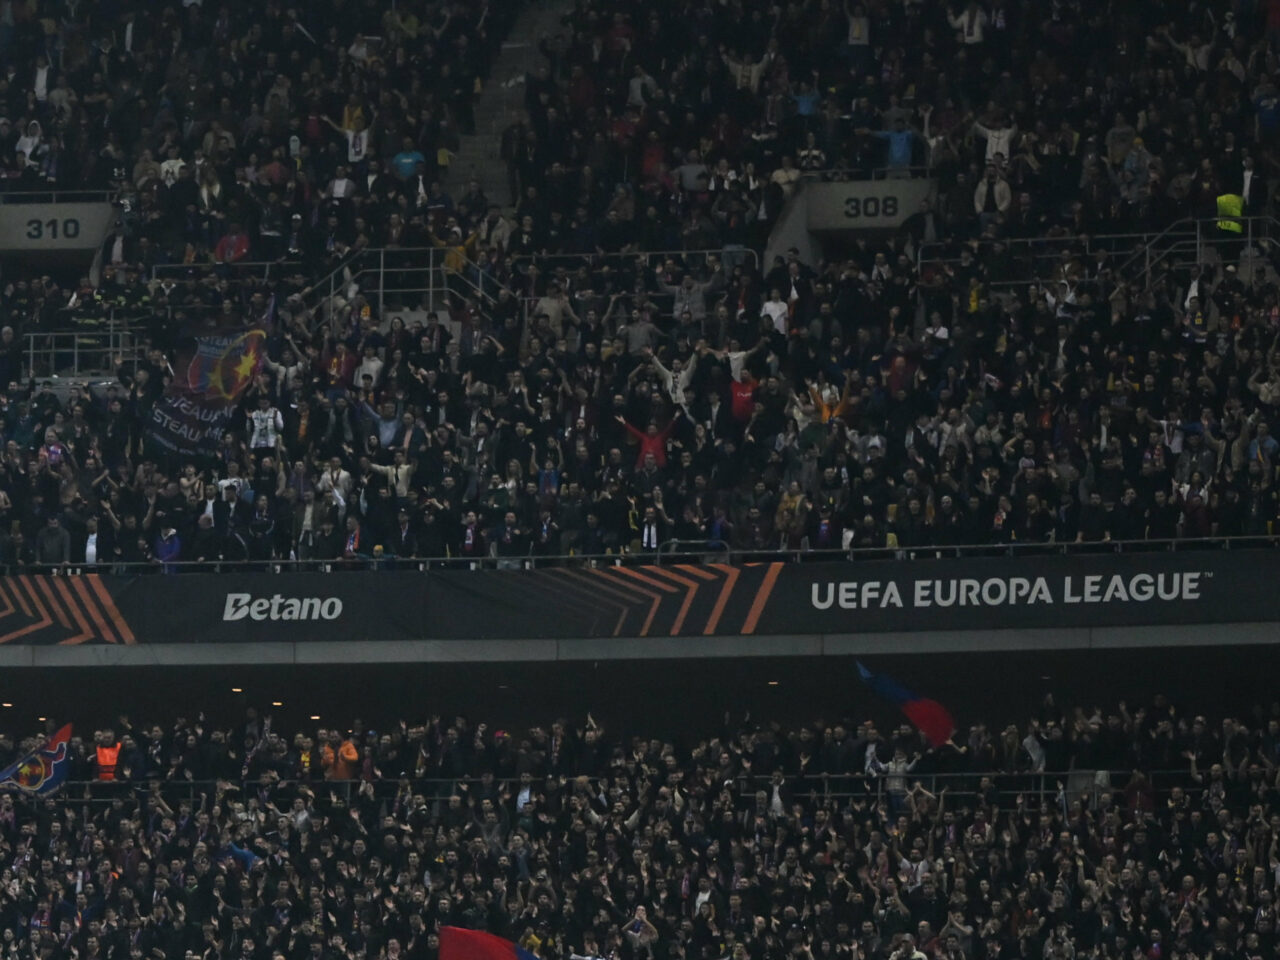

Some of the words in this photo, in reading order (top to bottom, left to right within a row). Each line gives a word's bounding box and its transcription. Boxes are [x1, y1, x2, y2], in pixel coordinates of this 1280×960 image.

[844, 196, 899, 218] 308
[26, 219, 80, 239] 310
[811, 581, 904, 610] UEFA
[913, 576, 1054, 607] EUROPA
[222, 593, 343, 621] Betano
